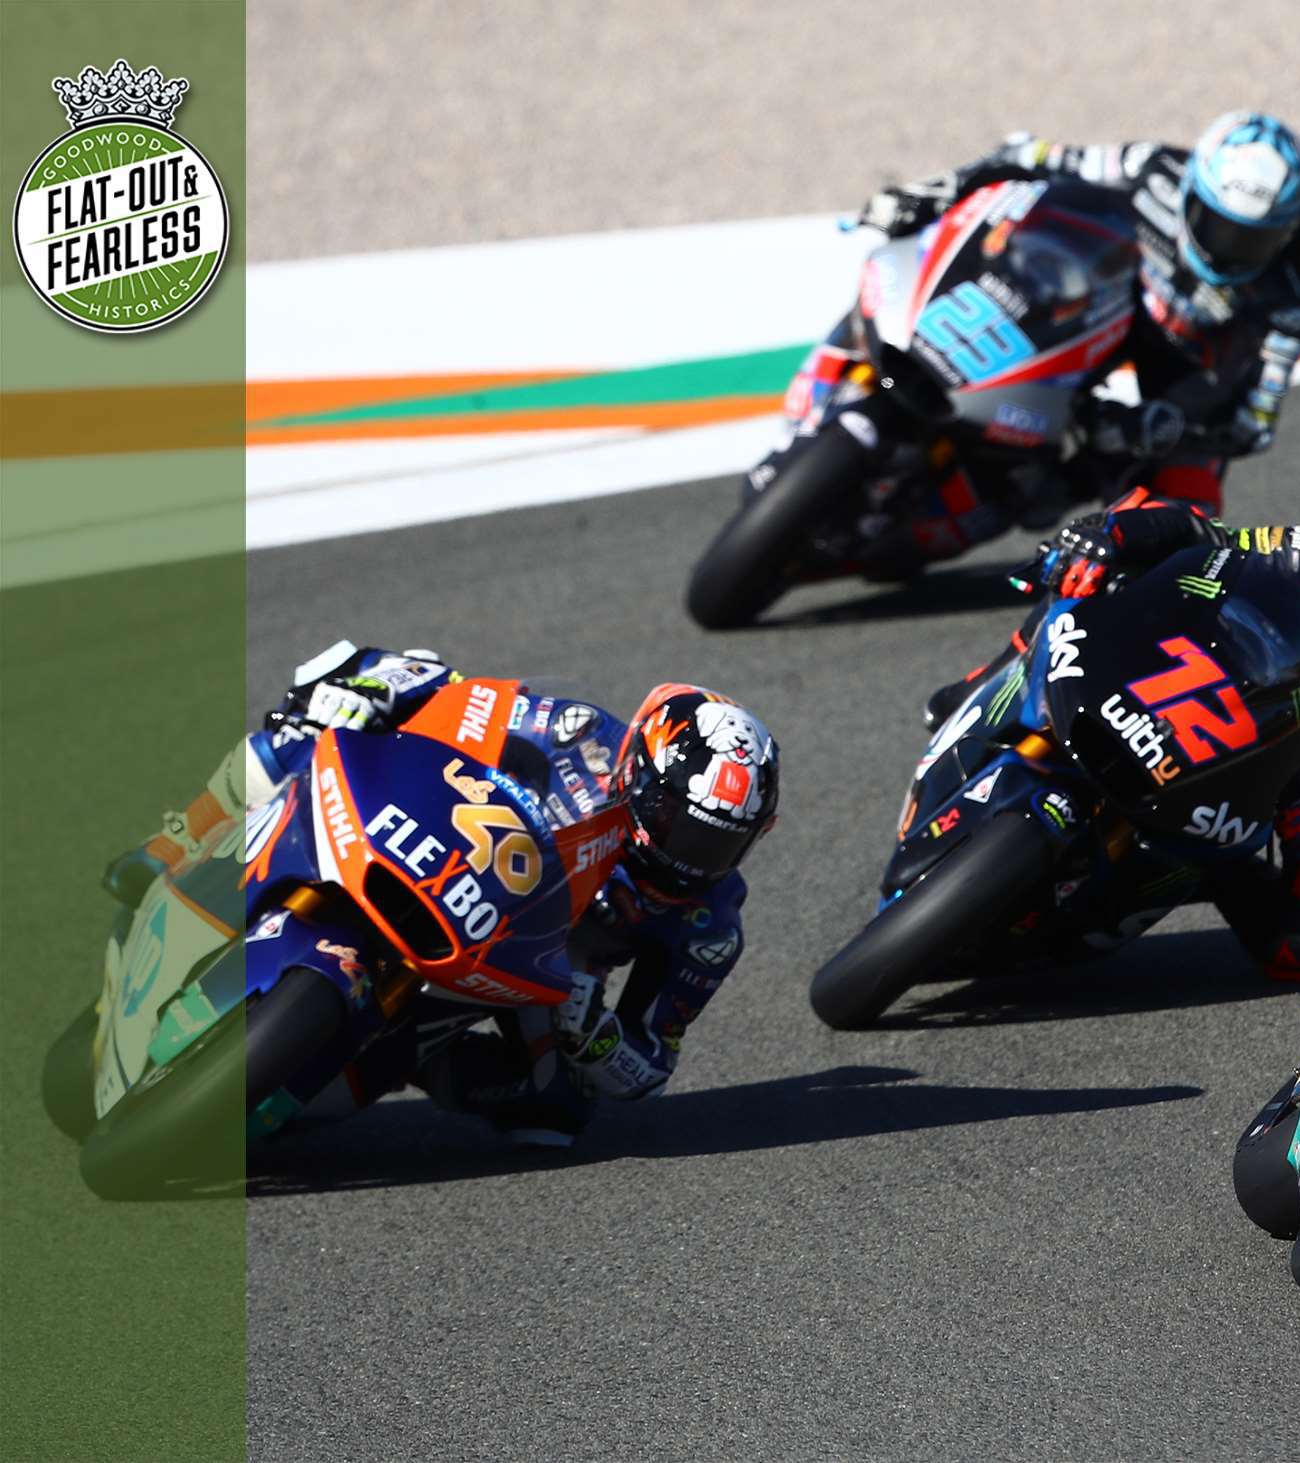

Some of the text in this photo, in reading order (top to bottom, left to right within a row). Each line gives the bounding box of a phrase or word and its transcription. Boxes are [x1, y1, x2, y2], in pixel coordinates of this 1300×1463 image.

[914, 280, 1040, 382] 23
[1047, 612, 1088, 683] sky
[456, 684, 498, 744] STIHL
[318, 766, 358, 861] STIHL
[1183, 801, 1259, 848] sky
[364, 803, 516, 971] FLEXBOX
[455, 972, 535, 1002] STIHL
